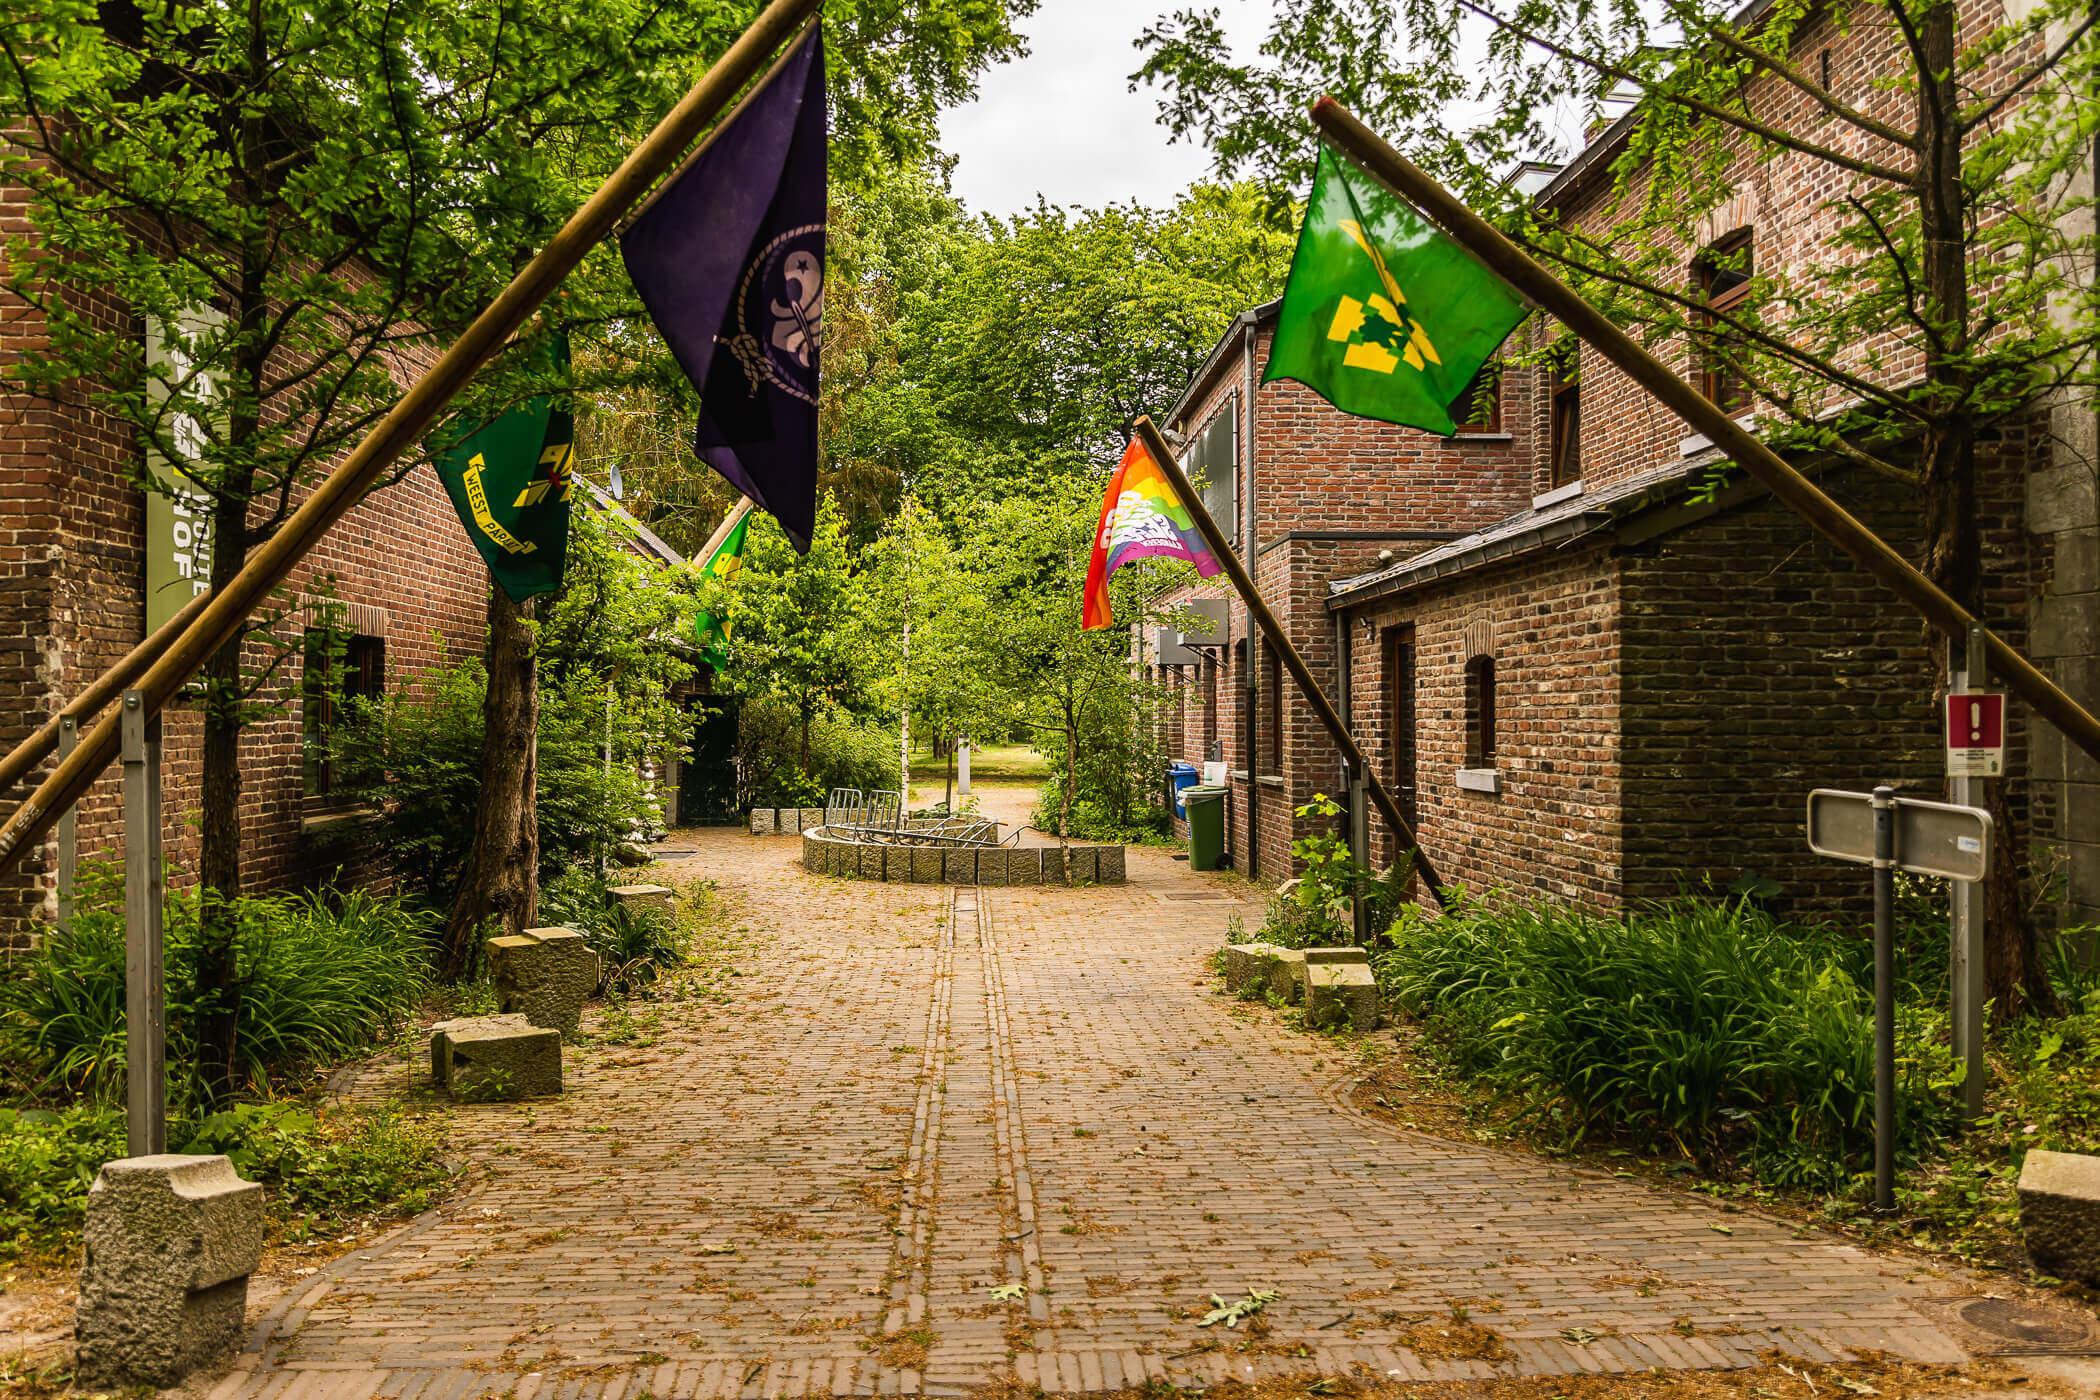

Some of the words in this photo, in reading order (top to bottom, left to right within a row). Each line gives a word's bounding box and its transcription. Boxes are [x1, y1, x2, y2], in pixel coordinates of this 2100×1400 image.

[173, 488, 192, 579] HOF
[466, 473, 488, 516] WEEST
[193, 494, 211, 596] WOUTE
